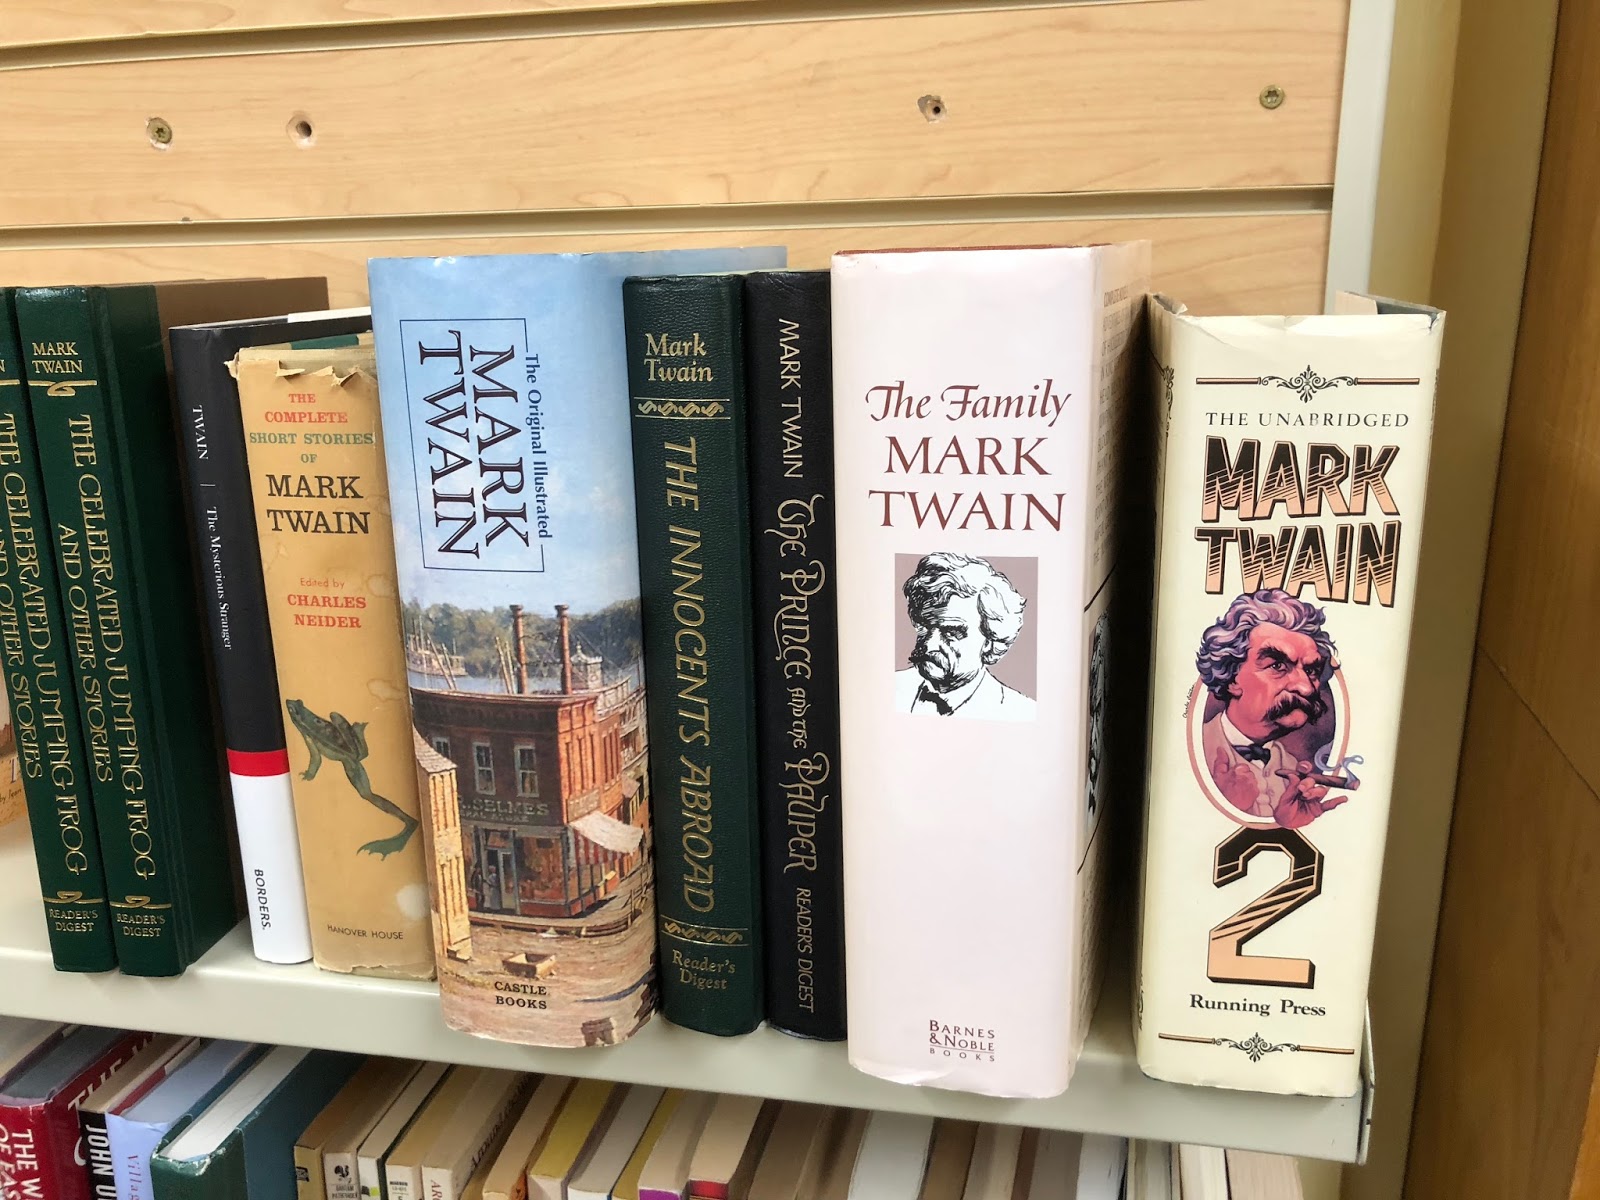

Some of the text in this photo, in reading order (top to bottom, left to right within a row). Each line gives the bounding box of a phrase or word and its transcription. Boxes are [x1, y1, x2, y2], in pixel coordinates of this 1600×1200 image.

[32, 342, 78, 355] MARK
[645, 333, 706, 356] Mark
[32, 360, 83, 373] TWAIN
[644, 358, 713, 382] Twain
[288, 393, 316, 404] THE
[779, 318, 803, 478] MARK TWAIN
[865, 379, 1072, 427] The Family
[265, 411, 348, 423] COMPLETE
[1206, 412, 1409, 427] THE UNABRIDGED
[192, 405, 208, 460] TWAIN
[250, 432, 374, 445] SHORT STORIES
[418, 329, 480, 559] TWAIN
[300, 453, 318, 463] OF
[469, 345, 529, 547] MARK
[525, 353, 553, 539] The Original Illustrated
[884, 435, 1052, 476] MARK
[266, 474, 364, 499] MARK
[1201, 435, 1400, 522] MARK
[267, 509, 371, 534] TWAIN
[868, 490, 1067, 532] TWAIN
[1194, 520, 1401, 608] TWAIN
[206, 506, 231, 650] The Mysterious Stranger
[300, 578, 345, 590] Edited by
[287, 594, 367, 609] CHARLES
[294, 614, 361, 628] NEIDER
[0, 412, 88, 876] THE CELEBRATED JUMPING FROG
[58, 523, 114, 783] AND OTHER STORIES
[69, 414, 156, 880] THE CELEBRATED JUMPING FROG
[0, 583, 43, 779] OTHER STORIES
[664, 437, 715, 913] THE INNOCENTS ABROAD
[49, 908, 98, 920] READER'S
[1206, 823, 1324, 989] 2
[55, 922, 95, 932] DIGEST
[116, 913, 166, 925] READER'S
[122, 926, 162, 937] DIGEST
[327, 924, 404, 940] HANOVER HOUSE
[672, 949, 736, 974] Reader's
[494, 981, 547, 996] CASTLE
[679, 968, 728, 990] Digest
[797, 957, 814, 1013] DIGEST
[495, 996, 547, 1010] BOOKS
[1189, 994, 1326, 1017] Running Press
[929, 1047, 995, 1062] BOOKS
[12, 1129, 44, 1200] THE W
[85, 1124, 117, 1200] JOHN U
[430, 1179, 443, 1200] AR
